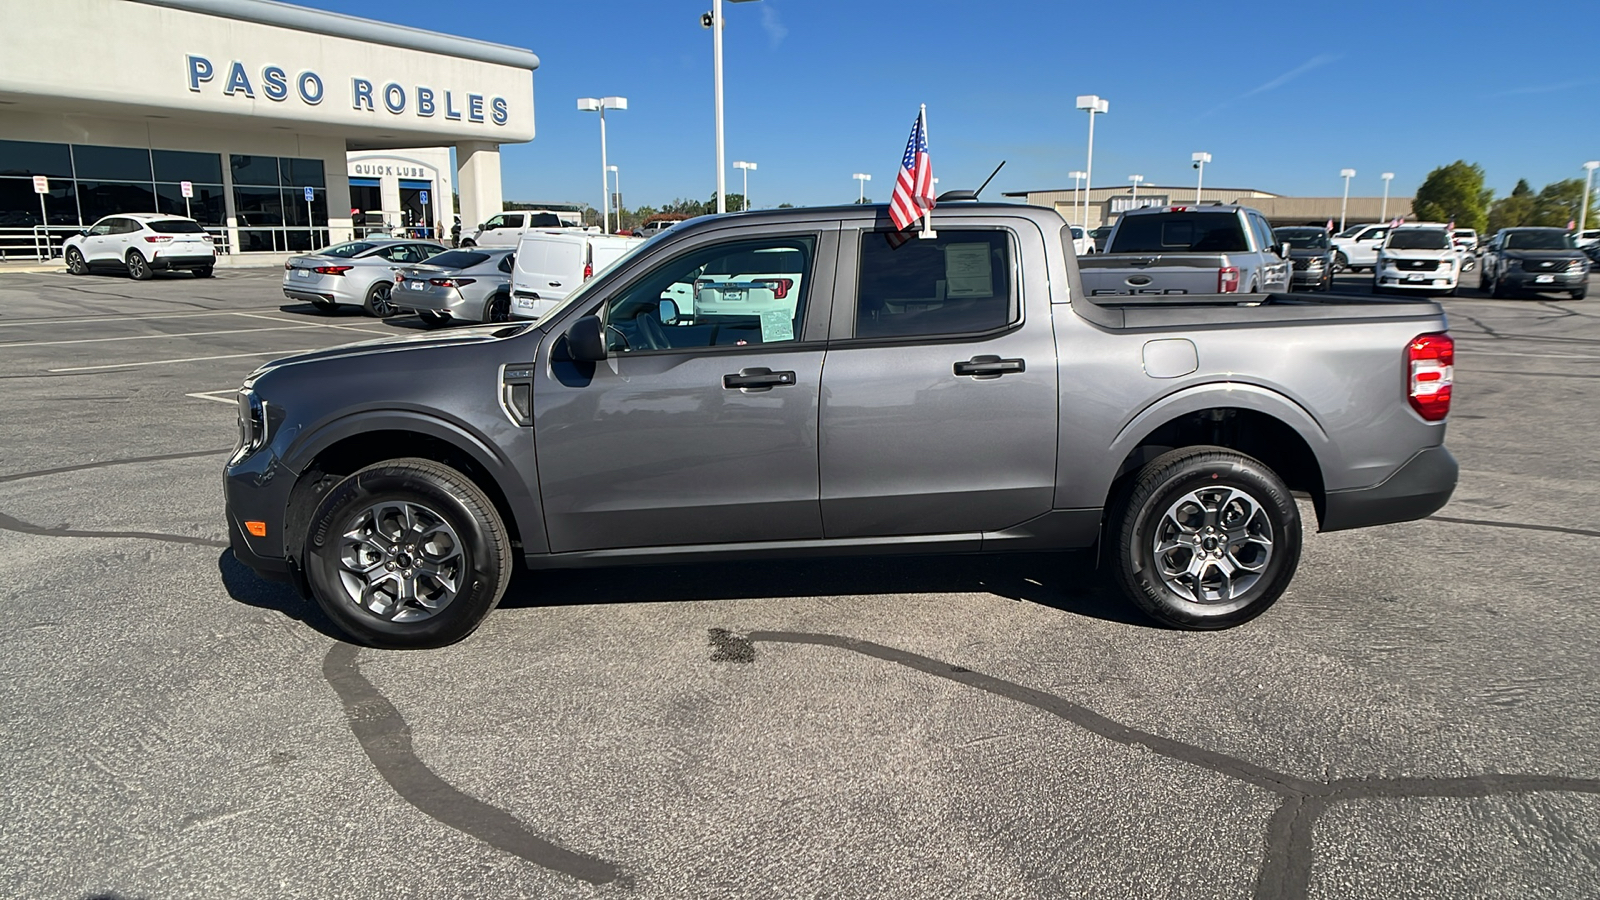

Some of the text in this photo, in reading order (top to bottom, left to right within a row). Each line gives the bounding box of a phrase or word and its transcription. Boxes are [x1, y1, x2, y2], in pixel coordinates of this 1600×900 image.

[186, 54, 509, 126] PASO ROBLES
[355, 164, 424, 177] QUICK LUBE
